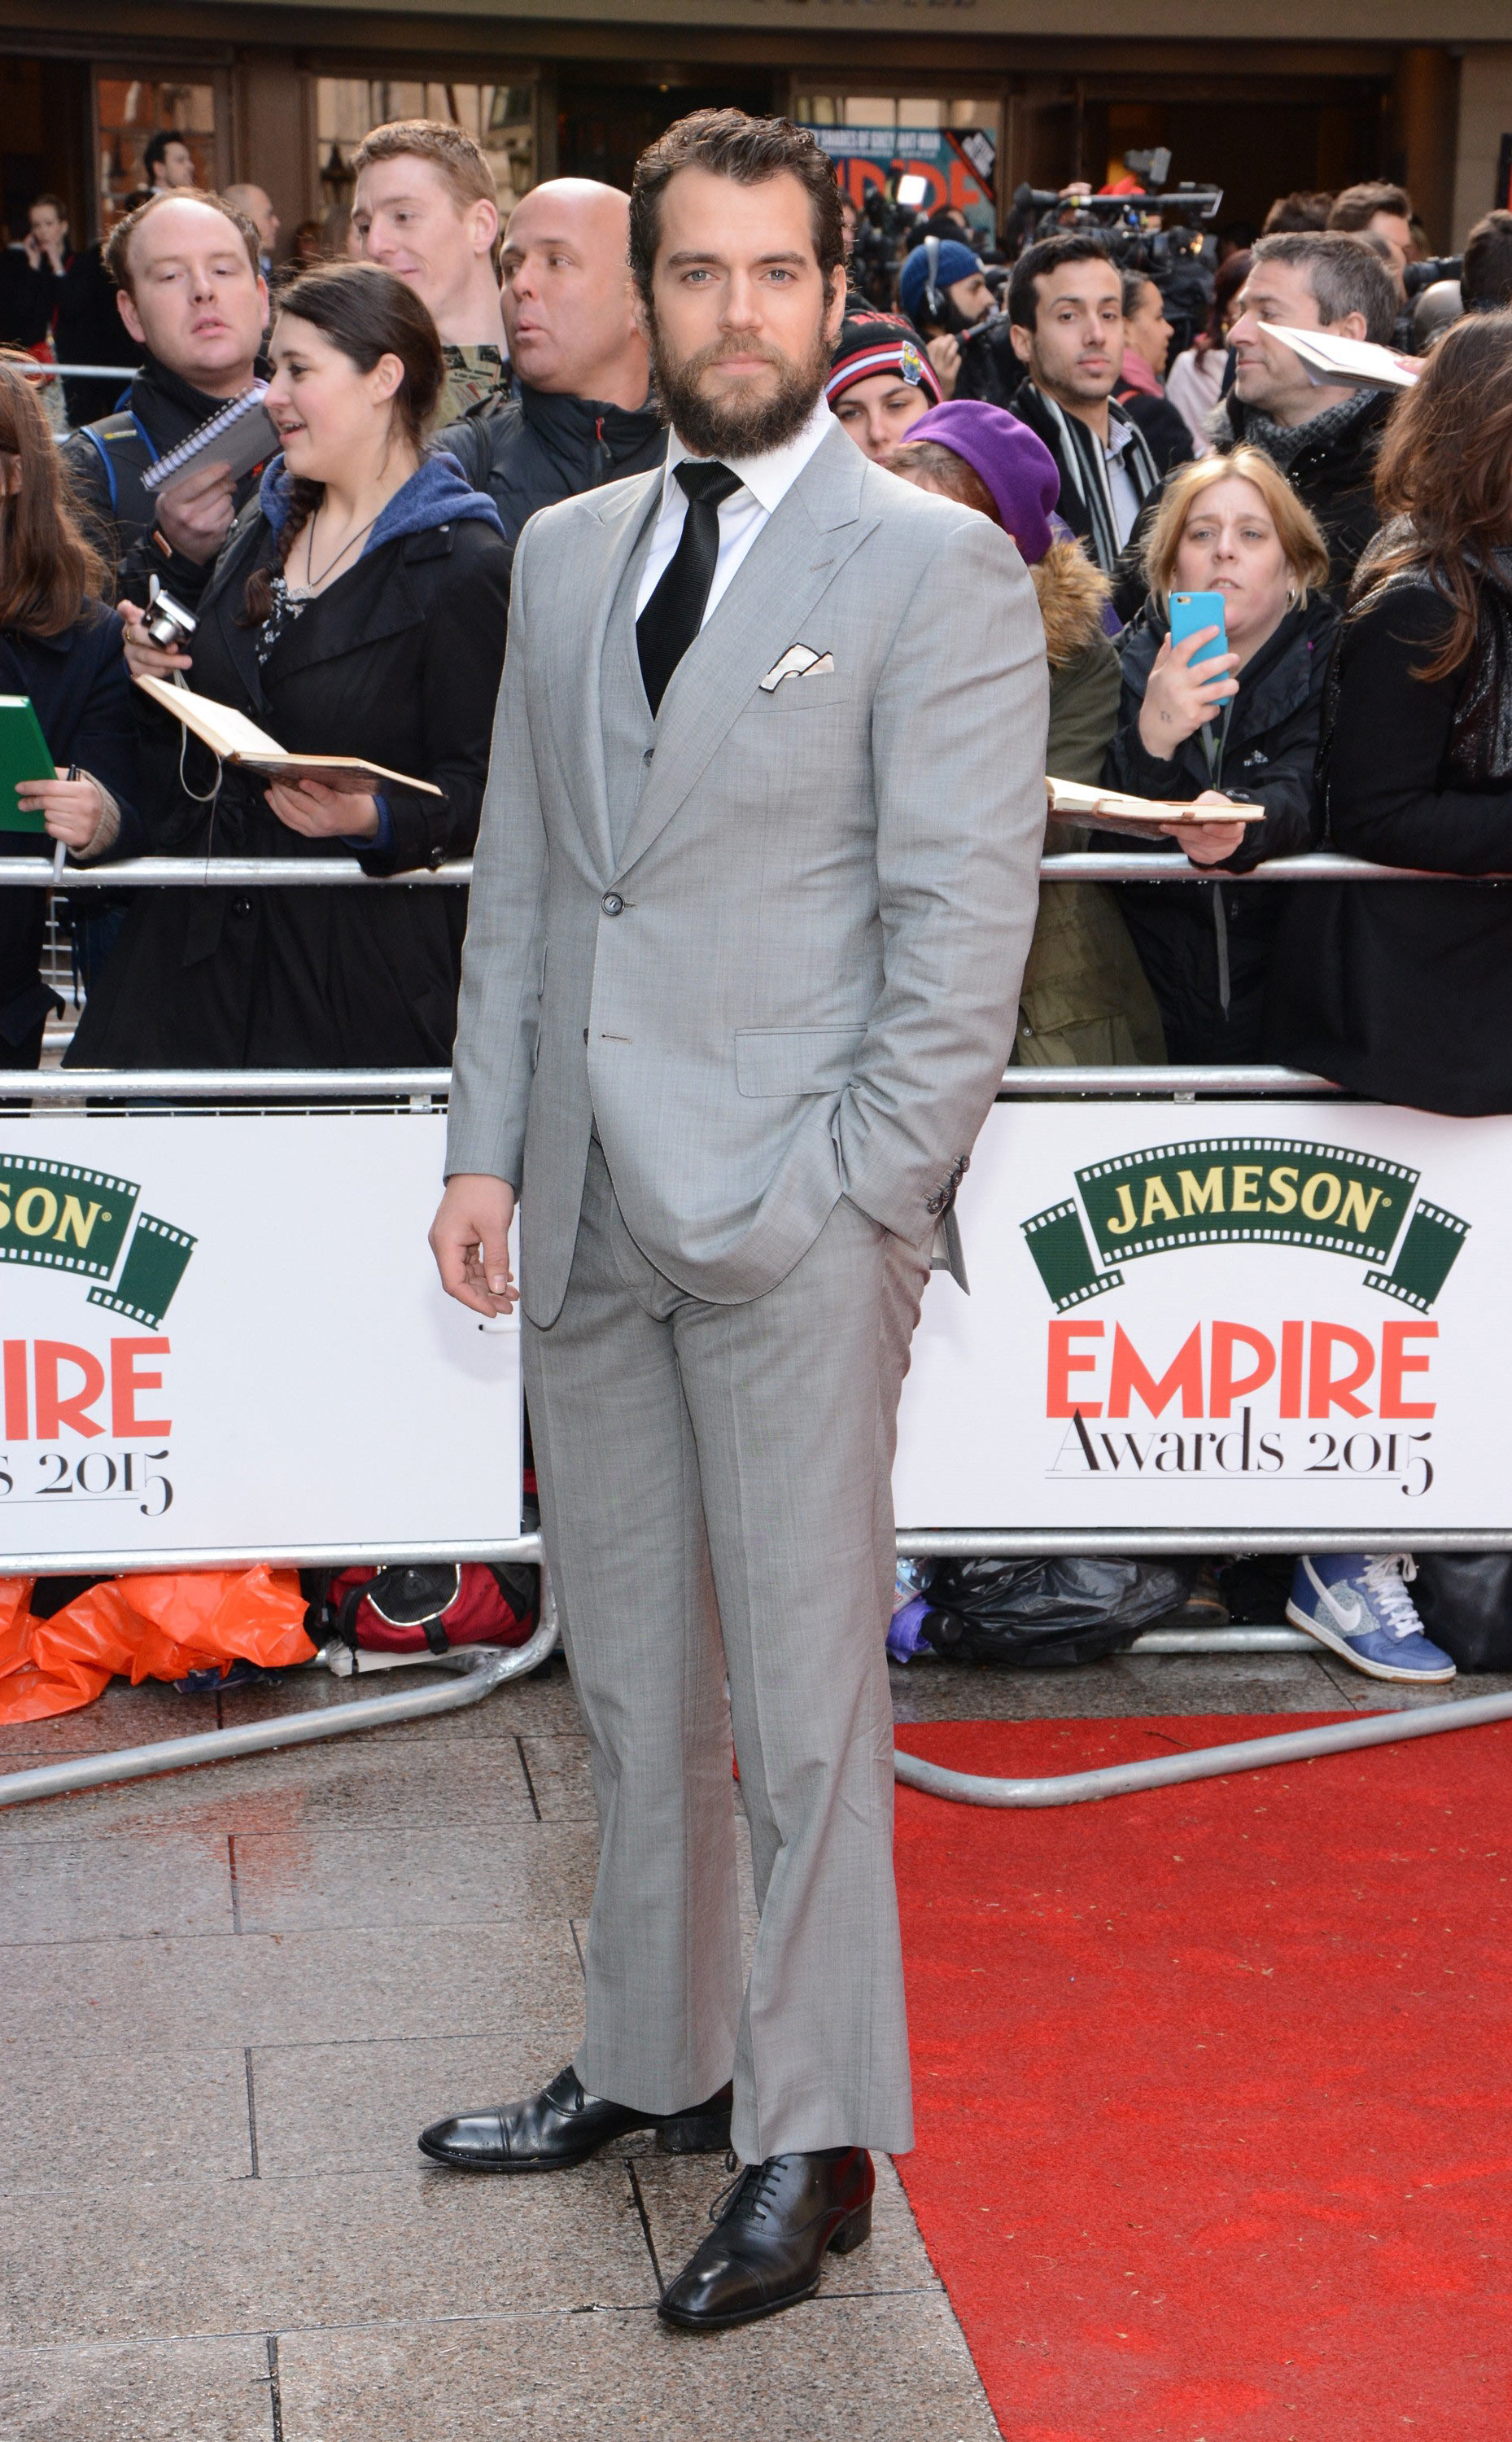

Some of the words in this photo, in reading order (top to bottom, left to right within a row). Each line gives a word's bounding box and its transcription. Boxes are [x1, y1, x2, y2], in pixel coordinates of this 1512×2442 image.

[2, 1337, 173, 1441] IRE
[1046, 1319, 1440, 1420] EMPIRE
[34, 1450, 173, 1516] 2015
[1045, 1406, 1284, 1473] Awards
[1303, 1431, 1435, 1497] 2015
